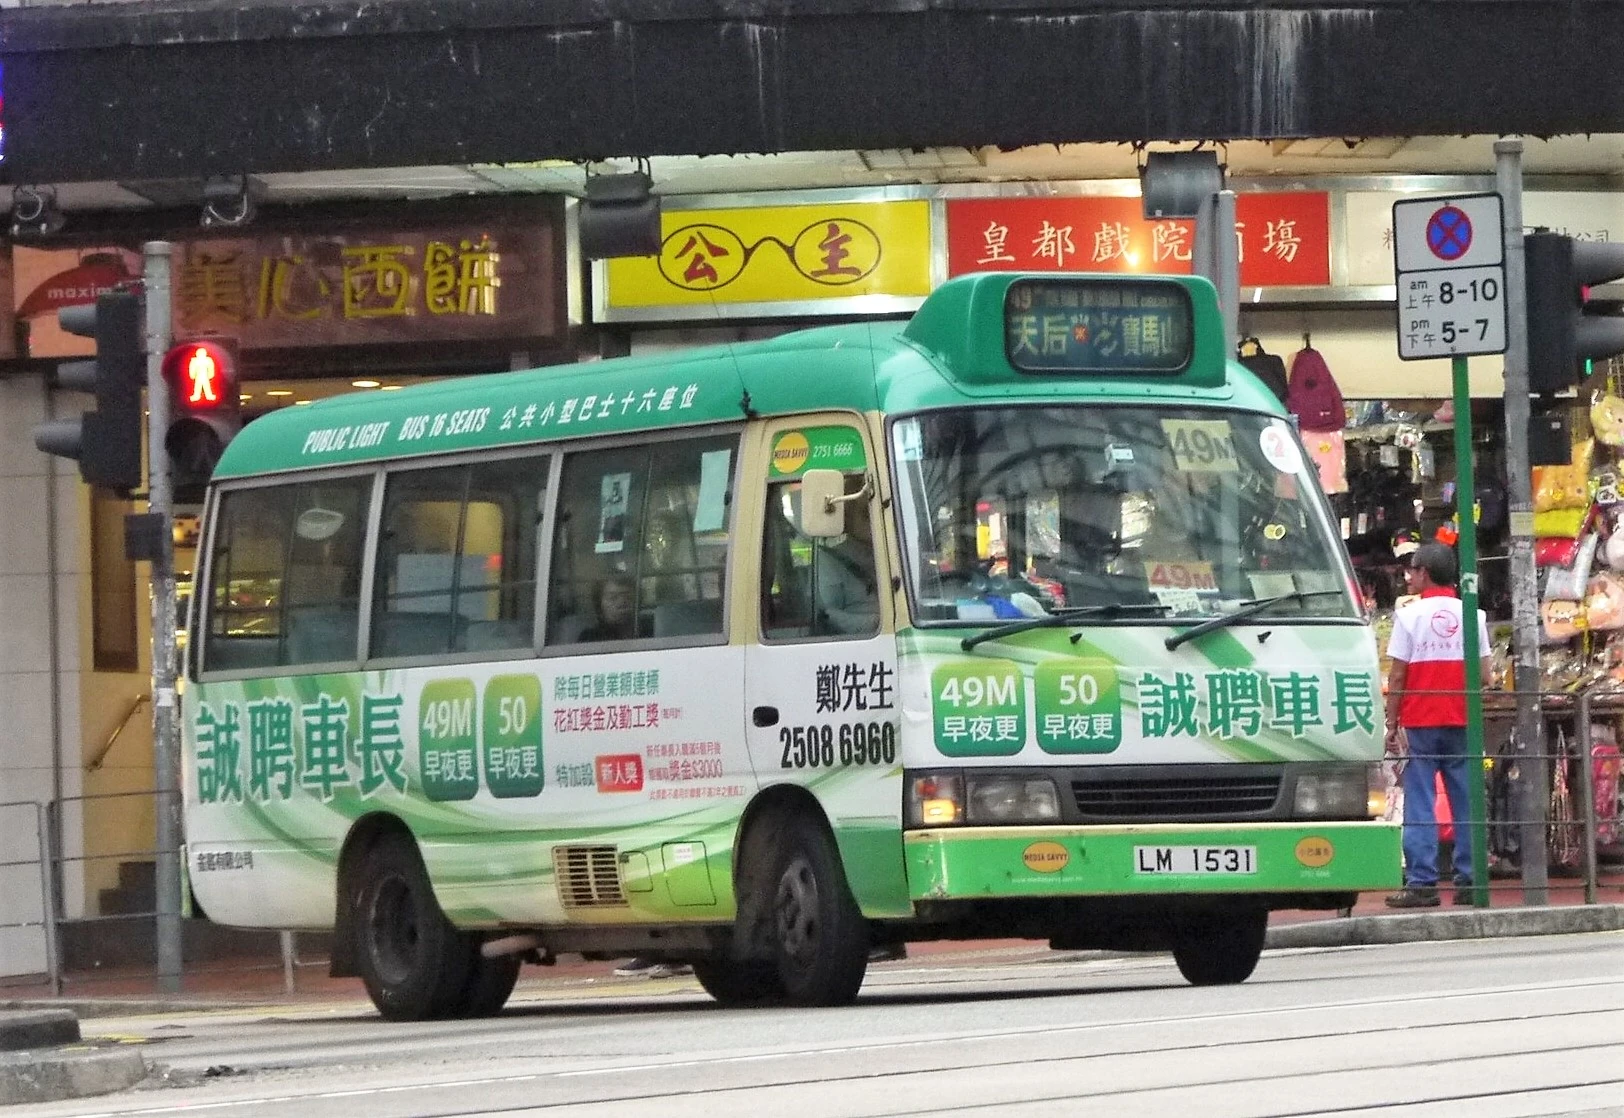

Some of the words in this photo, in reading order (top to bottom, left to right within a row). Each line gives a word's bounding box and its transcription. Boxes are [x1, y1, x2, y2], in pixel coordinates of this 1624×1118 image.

[976, 218, 1302, 267] 皇都戲院塲
[1405, 295, 1436, 310] 上午
[1439, 278, 1499, 304] 8-10
[1410, 280, 1428, 290] am
[1406, 334, 1437, 349] 下午
[1411, 319, 1430, 330] pm
[499, 382, 699, 431] 公共小型巴士十六座位
[302, 425, 349, 455] PUBLIC
[350, 421, 390, 450] LIGHT
[398, 415, 428, 442] BUS
[428, 412, 445, 437] 16
[445, 407, 490, 435] SEATS
[813, 445, 831, 458] 2751
[816, 661, 894, 714] 鄭先生
[940, 675, 1018, 708] 49M
[1060, 674, 1098, 705] 50
[1138, 669, 1376, 738] 誠聘車長
[423, 700, 474, 739] 49M
[500, 696, 527, 735] 50
[942, 715, 1020, 742] 早夜更
[1043, 713, 1114, 740] 早夜更
[196, 693, 406, 803] 誠聘車長
[780, 724, 834, 769] 2508
[840, 721, 895, 766] 6960
[424, 750, 475, 782] 早夜更
[489, 746, 540, 780] 早夜更
[1140, 849, 1173, 872] LM
[1193, 849, 1250, 872] 1531
